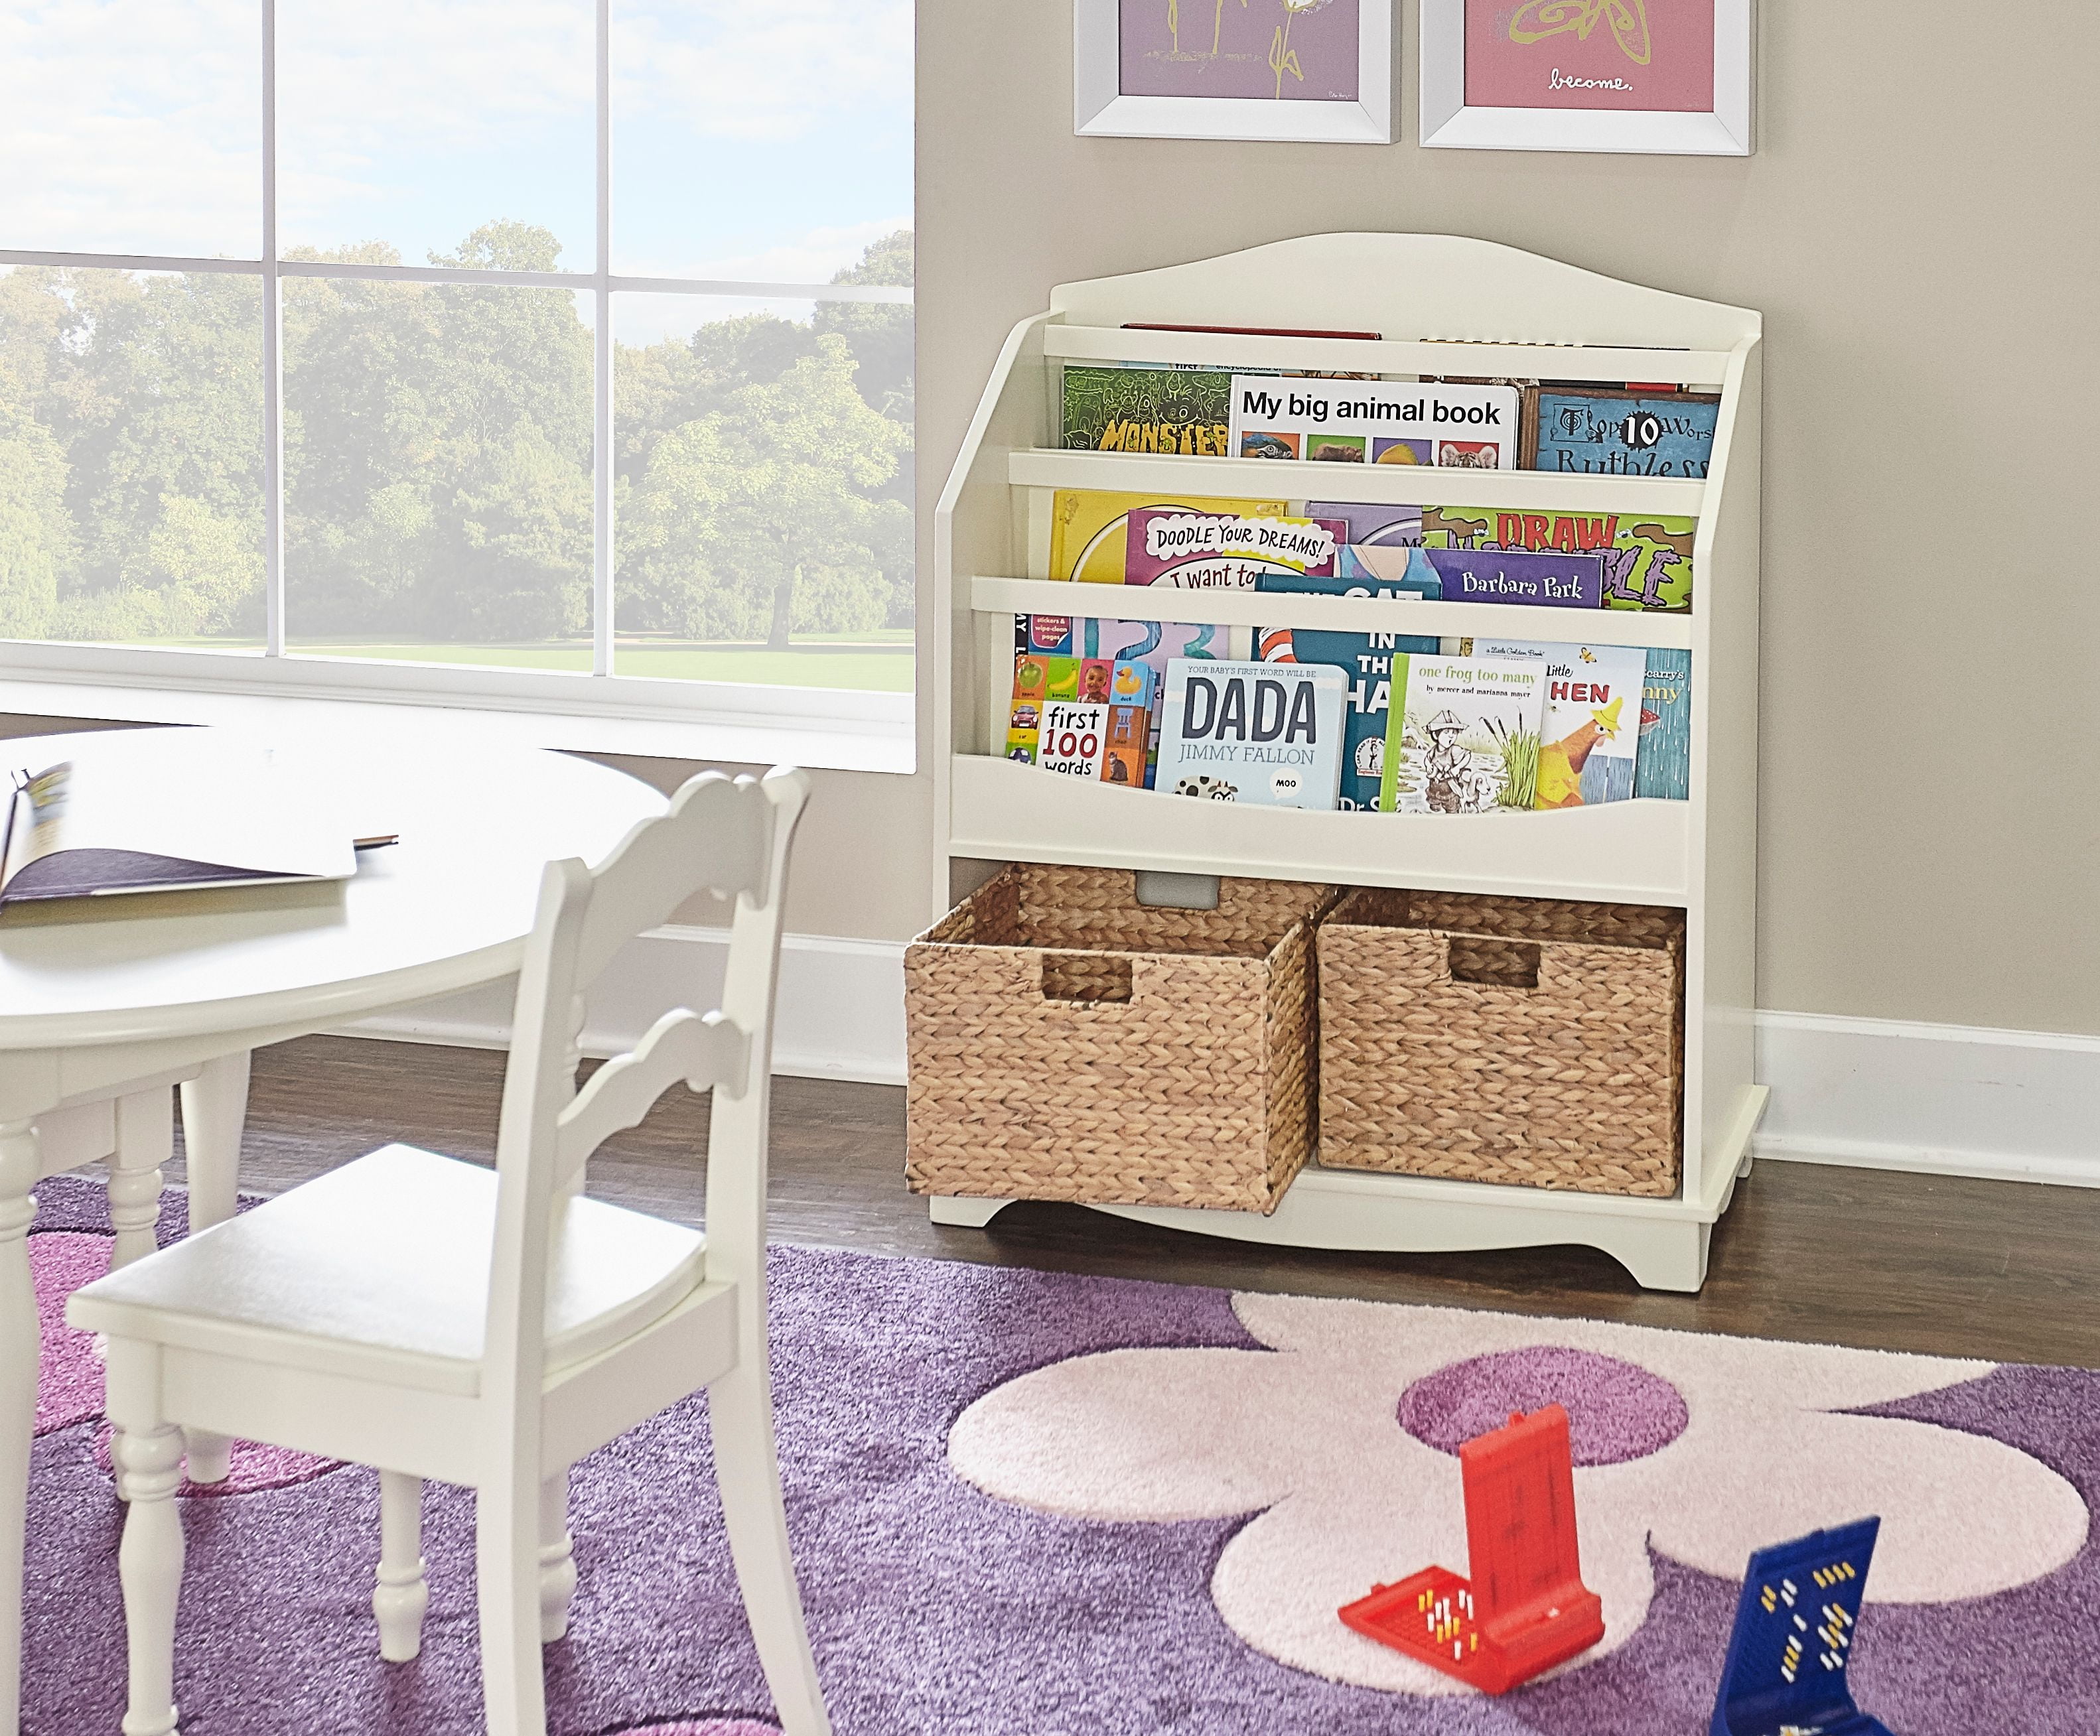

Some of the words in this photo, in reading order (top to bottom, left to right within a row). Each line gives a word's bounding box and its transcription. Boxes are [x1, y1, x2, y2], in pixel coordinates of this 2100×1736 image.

[1548, 68, 1634, 91] become.
[1243, 391, 1282, 419] My
[1289, 393, 1328, 422] big
[1336, 397, 1425, 421] animal
[1433, 399, 1501, 425] book
[1626, 417, 1659, 445] 10
[1663, 416, 1715, 441] Wors
[1156, 526, 1215, 549] DOODLE
[1259, 528, 1325, 559] DREAMS!
[1496, 513, 1620, 553] DRAW
[1187, 564, 1231, 589] want
[1237, 564, 1255, 587] to
[1462, 571, 1537, 596] Barbara
[1543, 576, 1583, 600] Park
[1369, 632, 1395, 649] IN
[1357, 655, 1393, 675] TH
[1419, 667, 1441, 677] one
[1445, 665, 1472, 684] frog
[1478, 669, 1498, 681] too
[1503, 673, 1538, 689] many
[1546, 664, 1573, 678] Little
[1645, 669, 1685, 681] carry's
[1348, 679, 1391, 714] HA
[1427, 685, 1434, 694] by
[1550, 681, 1610, 703] HEN
[1642, 687, 1683, 705] nny
[1048, 706, 1099, 730] first
[1182, 677, 1316, 744] DADA
[1042, 729, 1098, 758] 100
[1178, 744, 1239, 763] JIMMY
[1243, 746, 1316, 766] FALLON
[1044, 759, 1093, 775] words
